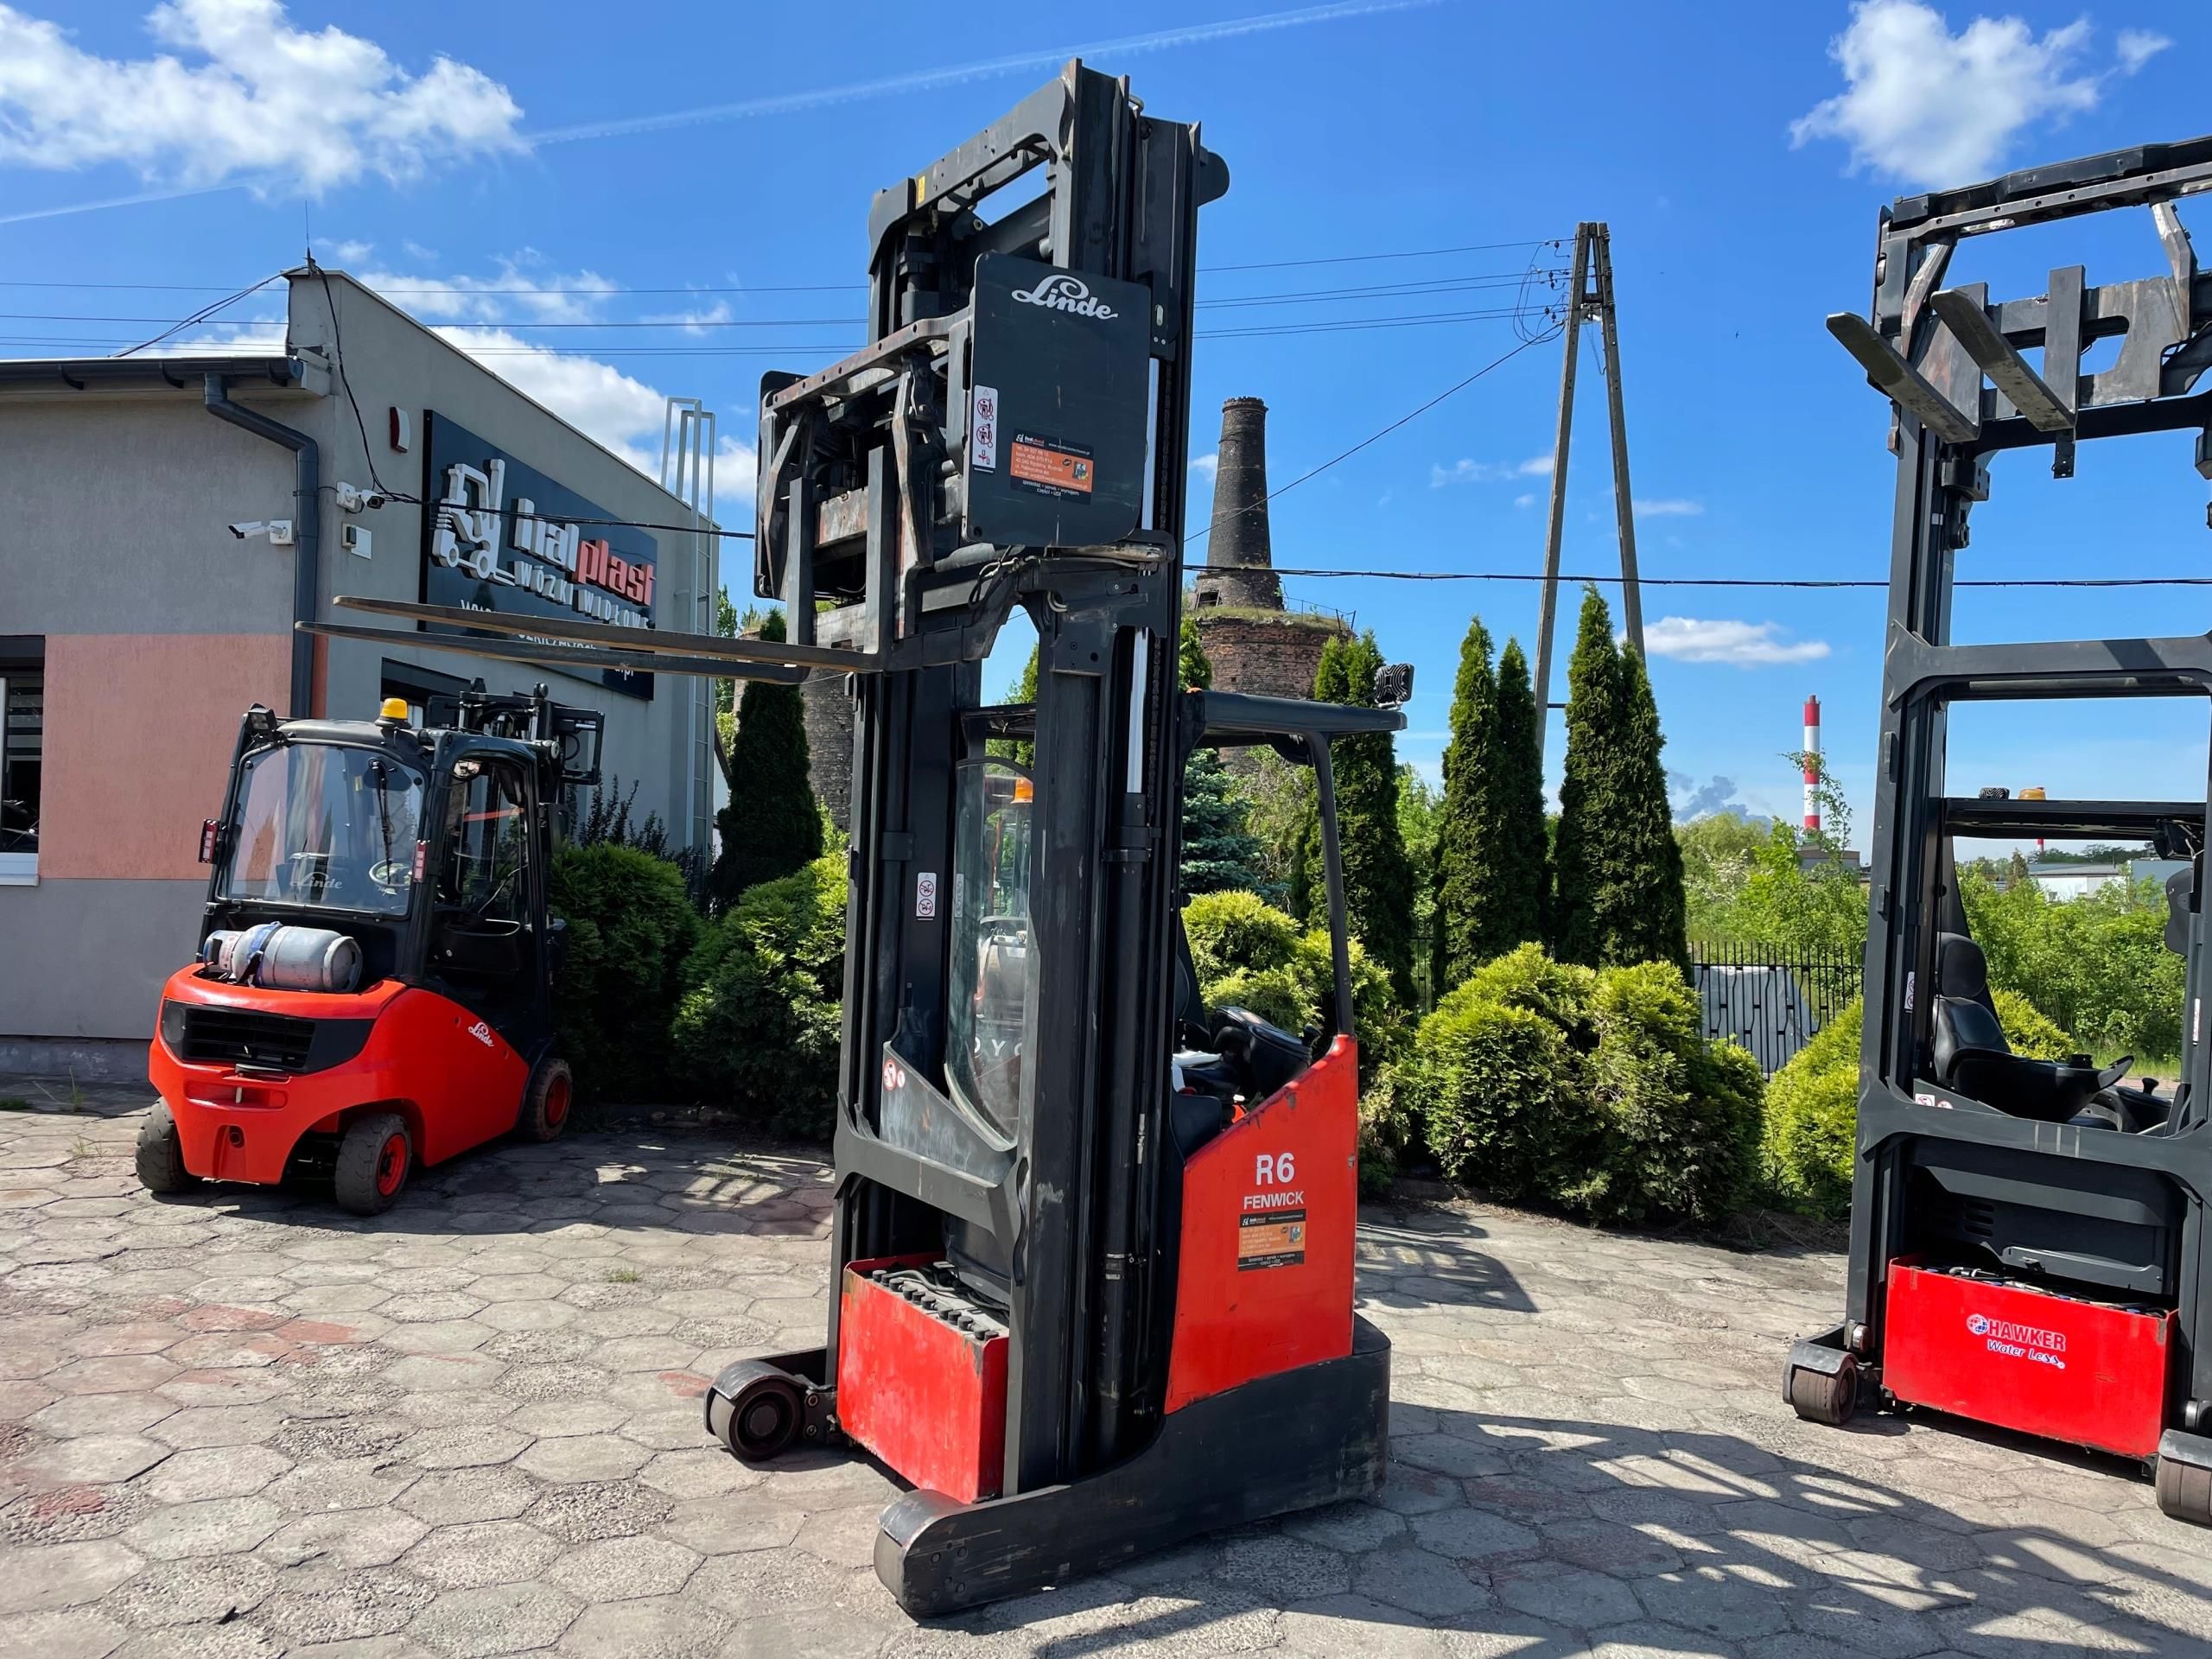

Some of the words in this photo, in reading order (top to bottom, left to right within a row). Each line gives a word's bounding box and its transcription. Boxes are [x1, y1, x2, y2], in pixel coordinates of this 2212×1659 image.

[1011, 274, 1119, 320] Linde
[515, 560, 574, 606] WÓZKI
[289, 871, 344, 890] Linde
[467, 1021, 494, 1047] Linde
[1255, 1152, 1295, 1185] R6
[1243, 1191, 1305, 1210] FENWICK
[1987, 1319, 2066, 1351] HAWKER
[1987, 1338, 2026, 1358] Water
